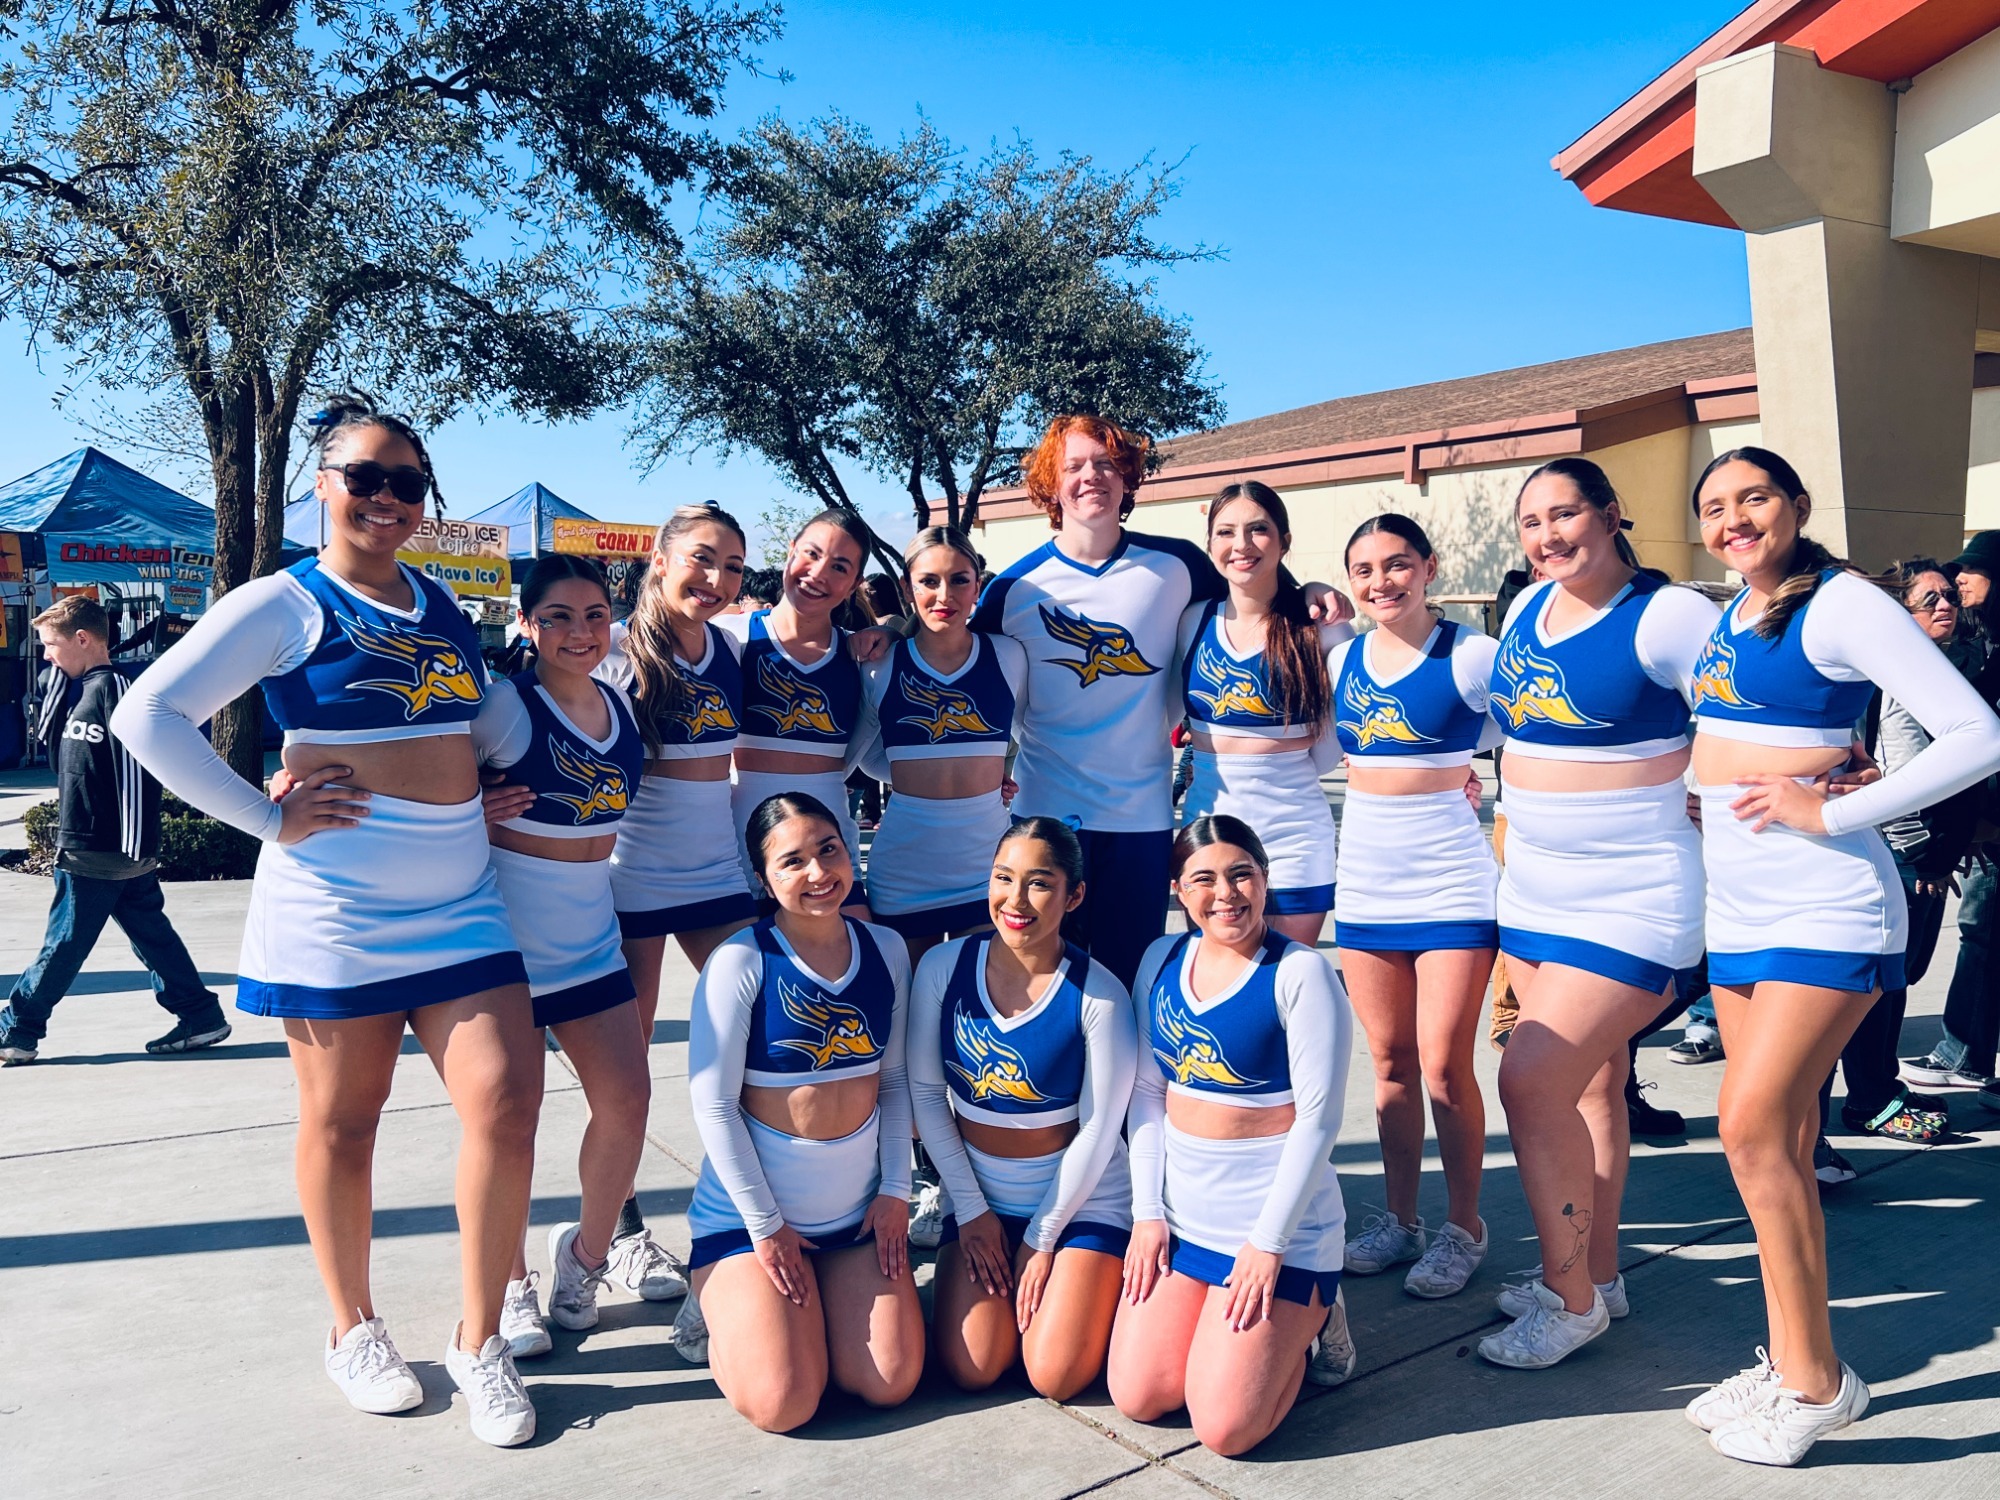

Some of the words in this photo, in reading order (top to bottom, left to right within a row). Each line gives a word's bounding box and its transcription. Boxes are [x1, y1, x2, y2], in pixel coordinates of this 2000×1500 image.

[413, 520, 469, 539] ENDED
[474, 525, 499, 542] ICE
[557, 526, 576, 539] Hand
[578, 524, 606, 537] Dipped
[61, 542, 172, 563] Chicken
[437, 537, 479, 556] Coffee
[595, 532, 639, 553] CORN
[137, 564, 172, 579] with
[424, 563, 472, 581] Shave
[475, 567, 497, 584] Ice
